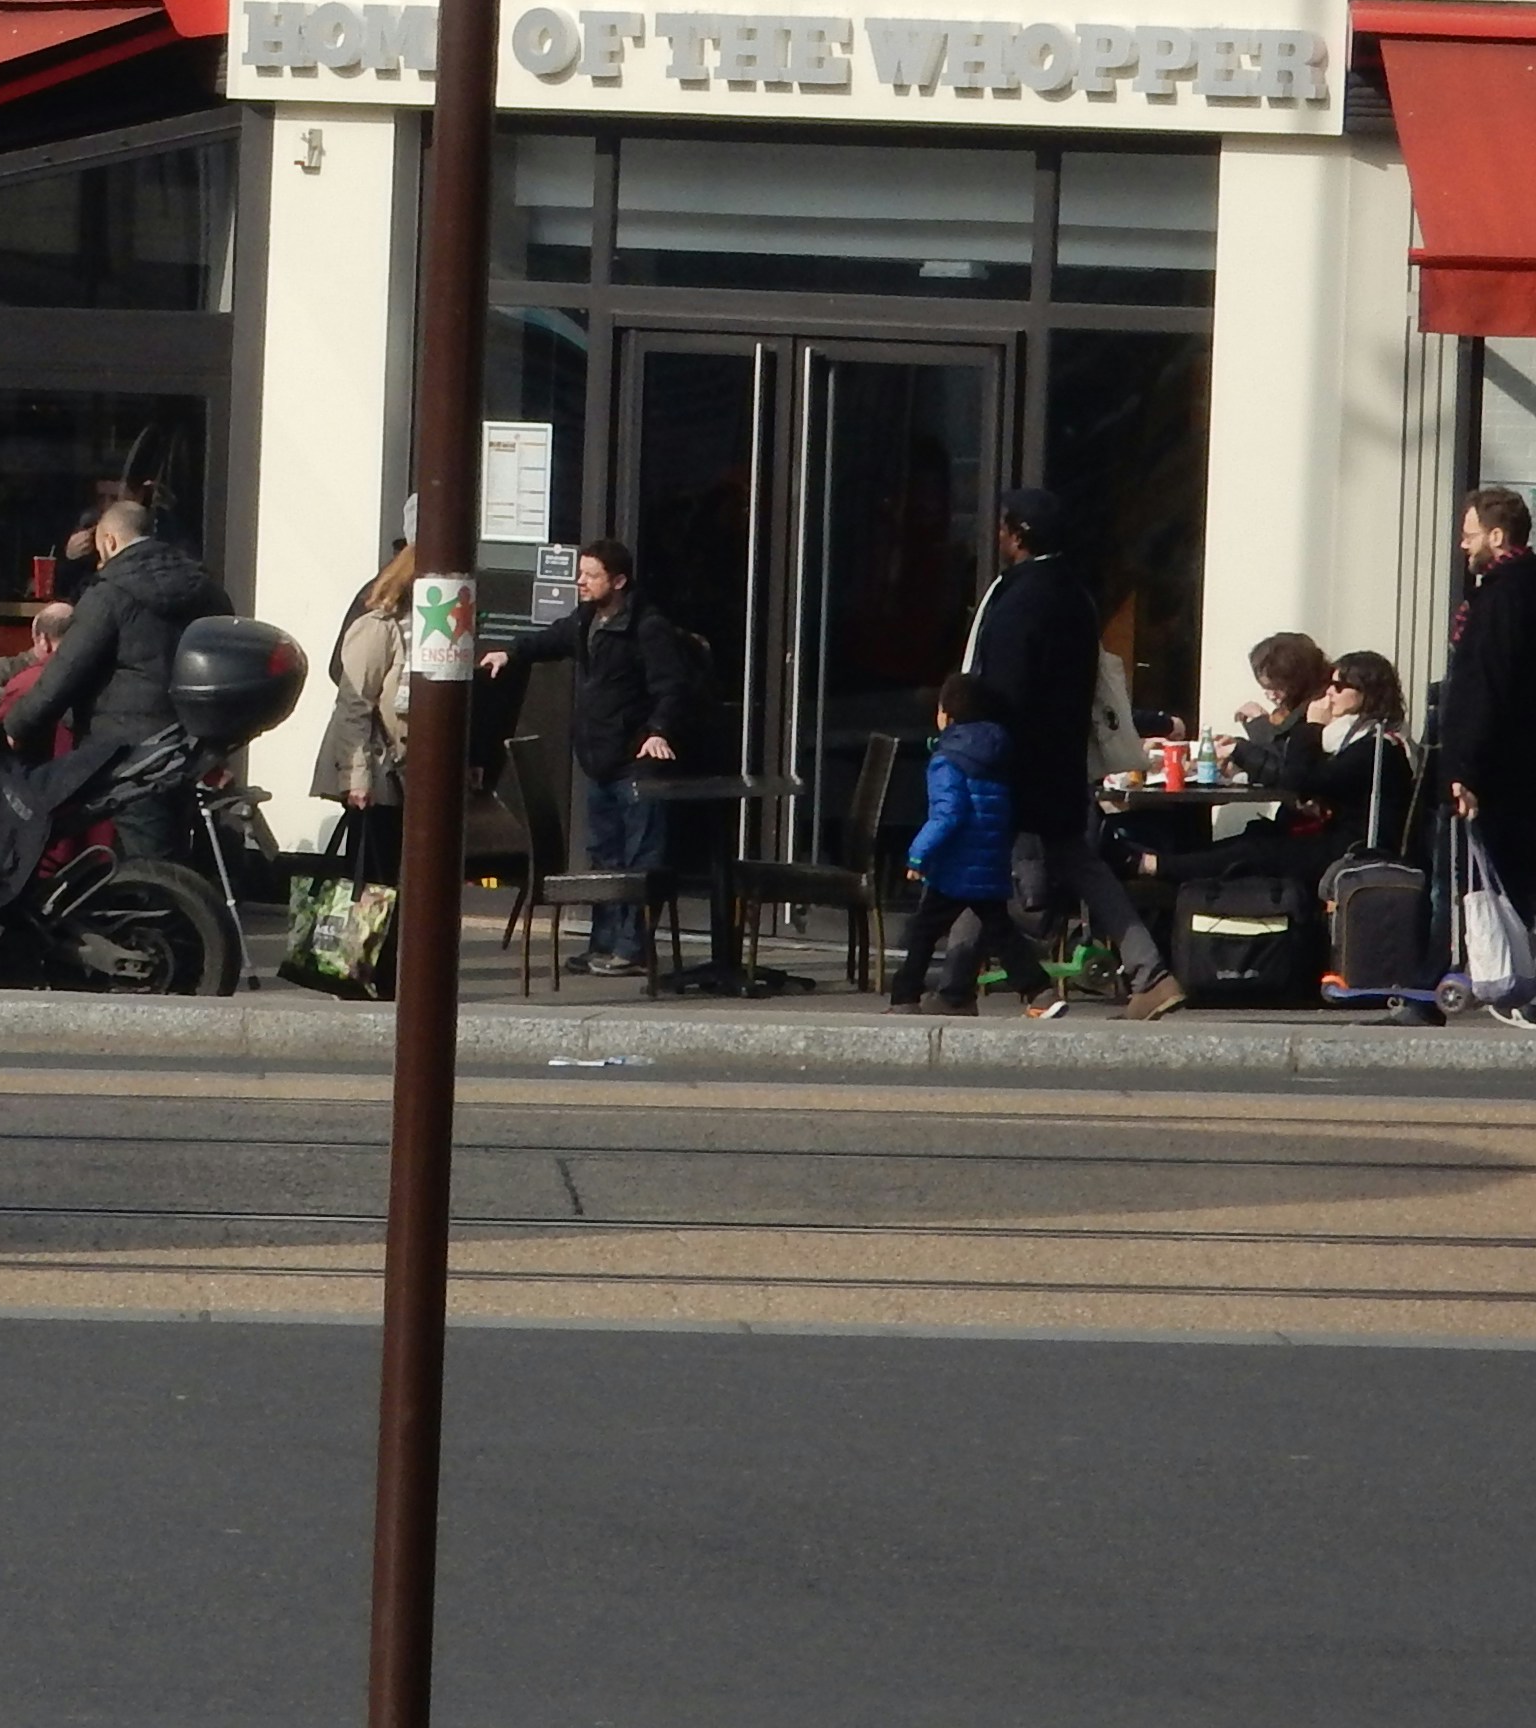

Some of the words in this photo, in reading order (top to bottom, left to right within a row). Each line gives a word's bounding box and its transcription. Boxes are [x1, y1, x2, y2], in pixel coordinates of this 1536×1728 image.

[512, 6, 645, 78] OF
[655, 11, 853, 85] THE
[864, 16, 1329, 100] WHOPPER
